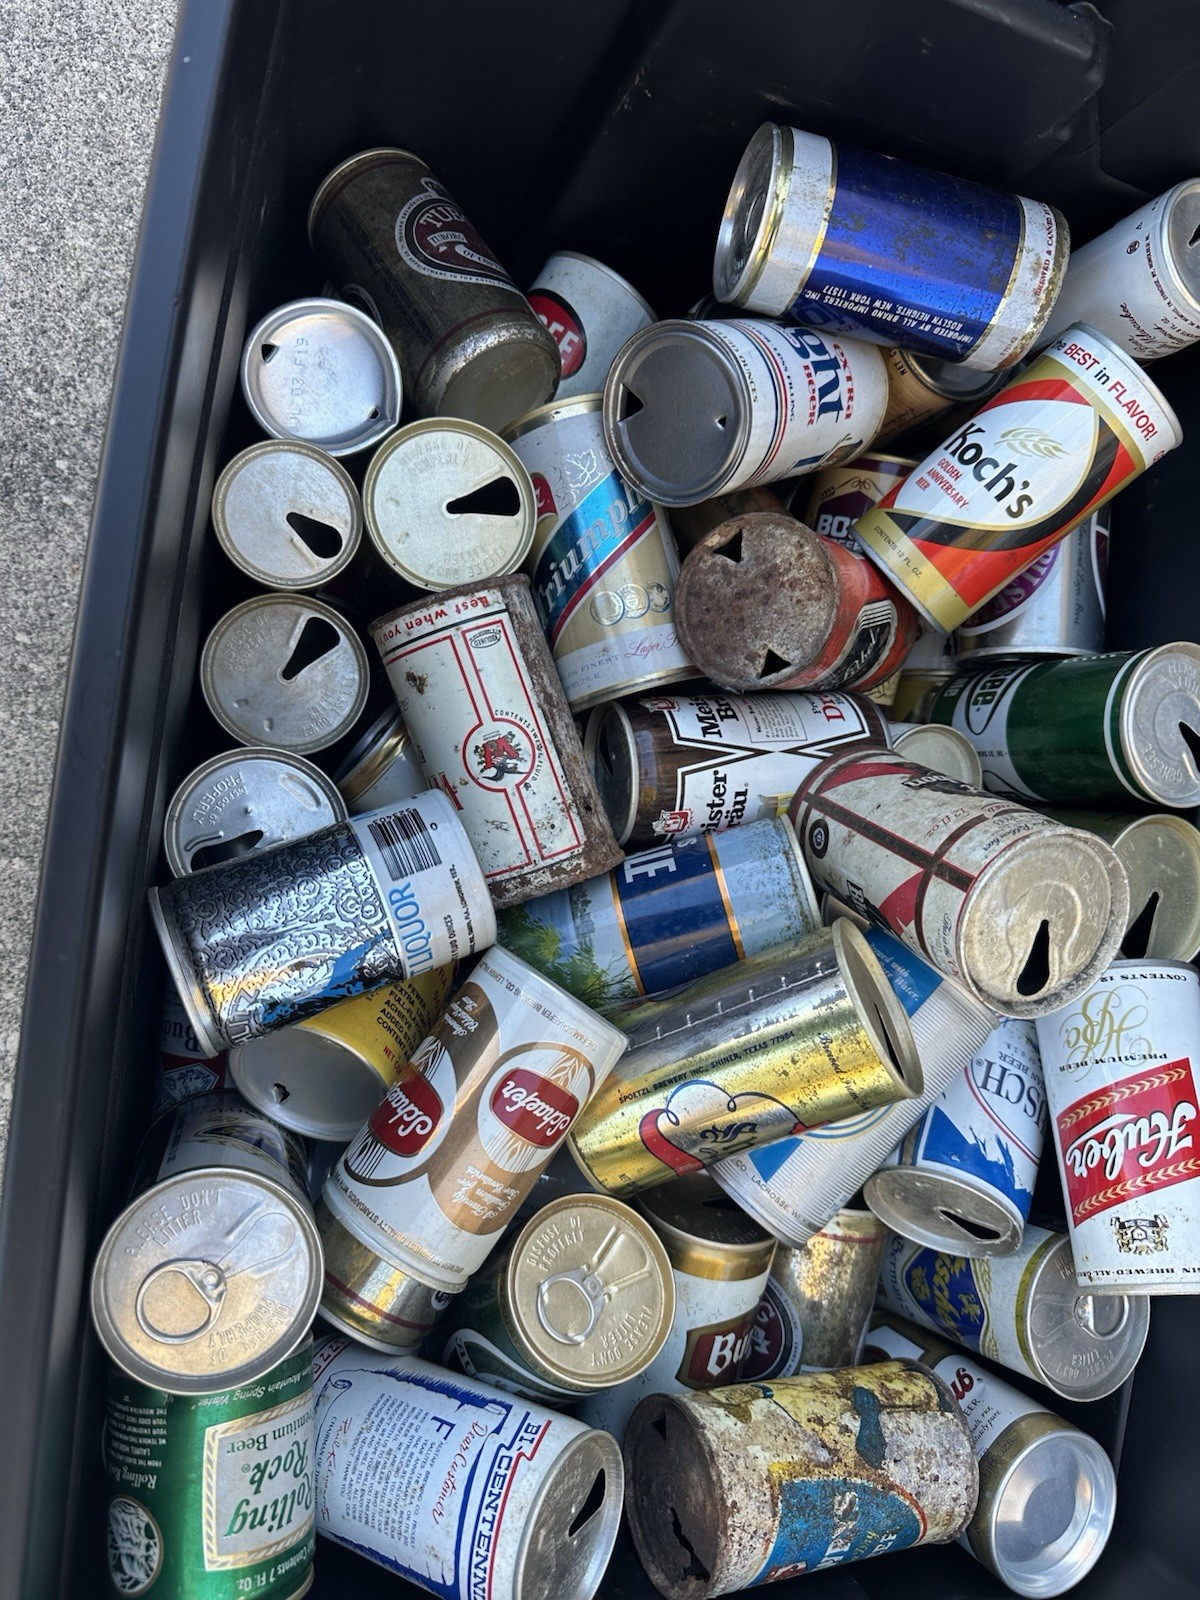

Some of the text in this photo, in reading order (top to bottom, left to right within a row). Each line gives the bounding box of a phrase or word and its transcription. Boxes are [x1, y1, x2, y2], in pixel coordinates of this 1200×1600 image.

[822, 285, 848, 299] 11577
[824, 296, 870, 314] IMPORTERS
[850, 292, 872, 305] YORK
[873, 300, 894, 311] NEW
[872, 309, 900, 322] BRAND
[896, 305, 931, 322] HEIGHTS,
[903, 318, 918, 328] ALL
[919, 322, 932, 332] BY
[933, 327, 974, 344] IMPORTED
[740, 356, 759, 403] OUNCES
[1064, 343, 1100, 371] BEST
[1094, 367, 1111, 386] in
[1107, 380, 1159, 442] FLAVOR!
[915, 476, 931, 491] BEER
[938, 458, 963, 482] GOLDEN
[944, 422, 1034, 519] Koch's
[926, 468, 969, 509] ANNIVERSARY
[874, 526, 905, 558] CONTENTS 12
[406, 596, 490, 631] Best when
[581, 637, 662, 673] FINEST Lager
[494, 709, 531, 729] CONTENTS
[193, 772, 245, 825] PROPERLY
[213, 786, 247, 814] DISPOSE
[389, 882, 434, 968] LIQUOR
[1121, 973, 1188, 982] CONTENTS
[393, 984, 415, 1008] EXTRA
[513, 986, 542, 1011] BREWING
[376, 1016, 407, 1051] CONTENT
[380, 1008, 404, 1034] ADDED
[541, 1007, 573, 1034] SCHAEFER
[572, 1029, 588, 1045] F&M
[383, 1045, 395, 1062] NET
[998, 1051, 1030, 1075] BEER
[1059, 1053, 1168, 1073] PREMIUM BEER
[619, 1088, 652, 1105] SPOETZL
[652, 1071, 687, 1091] BREWERY
[711, 1052, 742, 1070] SHINER,
[743, 1041, 769, 1057] TEXAS
[771, 1030, 796, 1045] 77984
[501, 1079, 572, 1137] Schaefer
[1066, 1100, 1198, 1182] Huber
[452, 1187, 488, 1217] Family
[457, 1178, 511, 1212] Tradition for
[751, 1174, 790, 1213] LACROSSE,
[348, 1191, 380, 1224] STANDARDS
[124, 1202, 174, 1257] PLEASE
[151, 1207, 204, 1249] LITTER
[377, 1220, 405, 1245] QUALITY
[405, 1241, 434, 1264] HIGHEST
[526, 1222, 564, 1269] DISPOSE
[537, 1229, 587, 1273] PROPERLY
[234, 1375, 301, 1402] Spring Mountain
[227, 1434, 268, 1454] Beer
[318, 1416, 337, 1455] CHAIRMAN
[249, 1438, 309, 1496] Rock
[431, 1420, 489, 1525] Dear Customer
